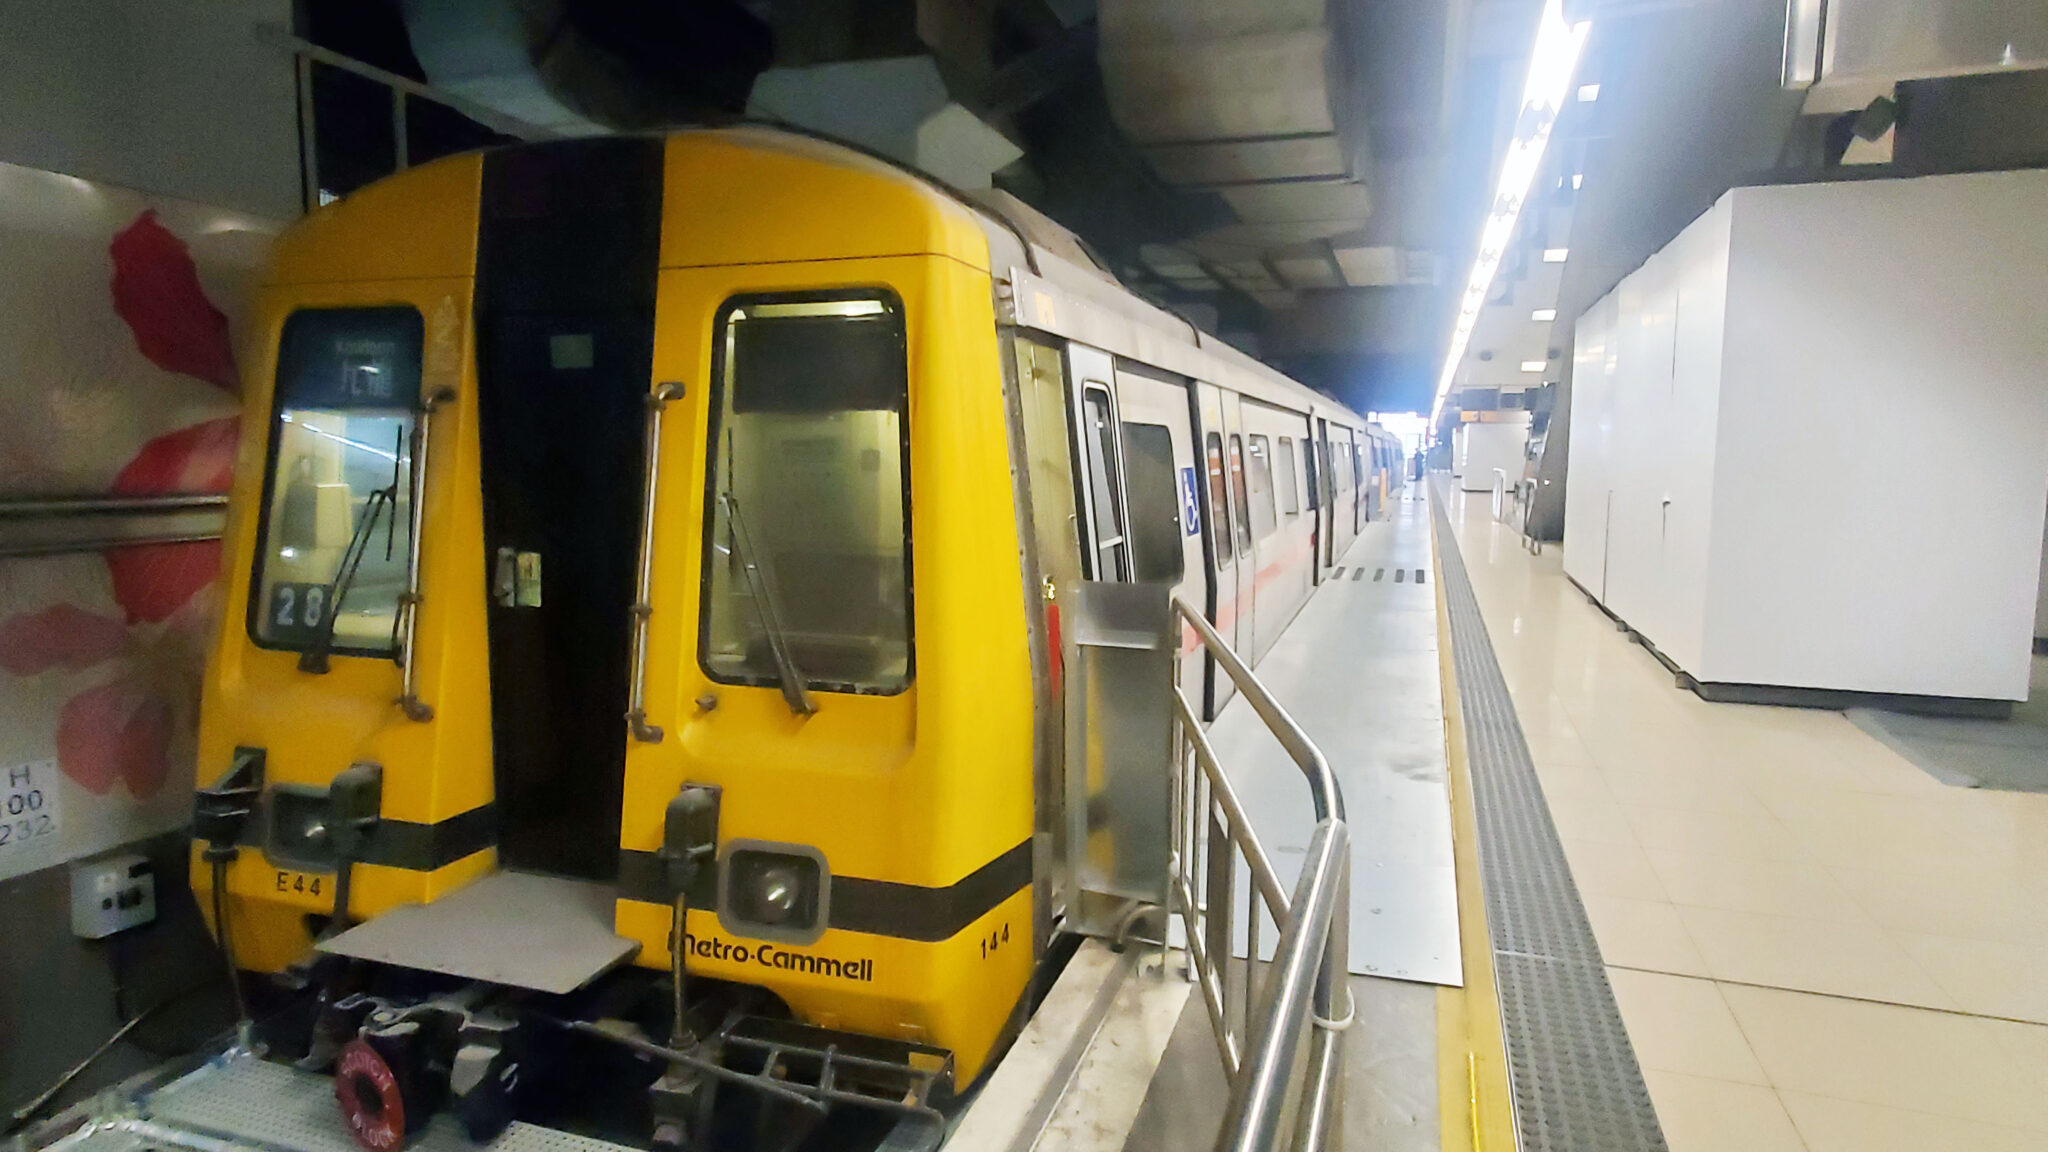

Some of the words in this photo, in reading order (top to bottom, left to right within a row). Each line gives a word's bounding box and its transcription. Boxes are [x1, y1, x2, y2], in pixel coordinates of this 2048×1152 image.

[276, 586, 324, 629] 28
[9, 764, 31, 788] H
[0, 789, 43, 816] 00
[0, 814, 51, 847] 232
[276, 870, 322, 897] E44
[980, 921, 1010, 961] 144
